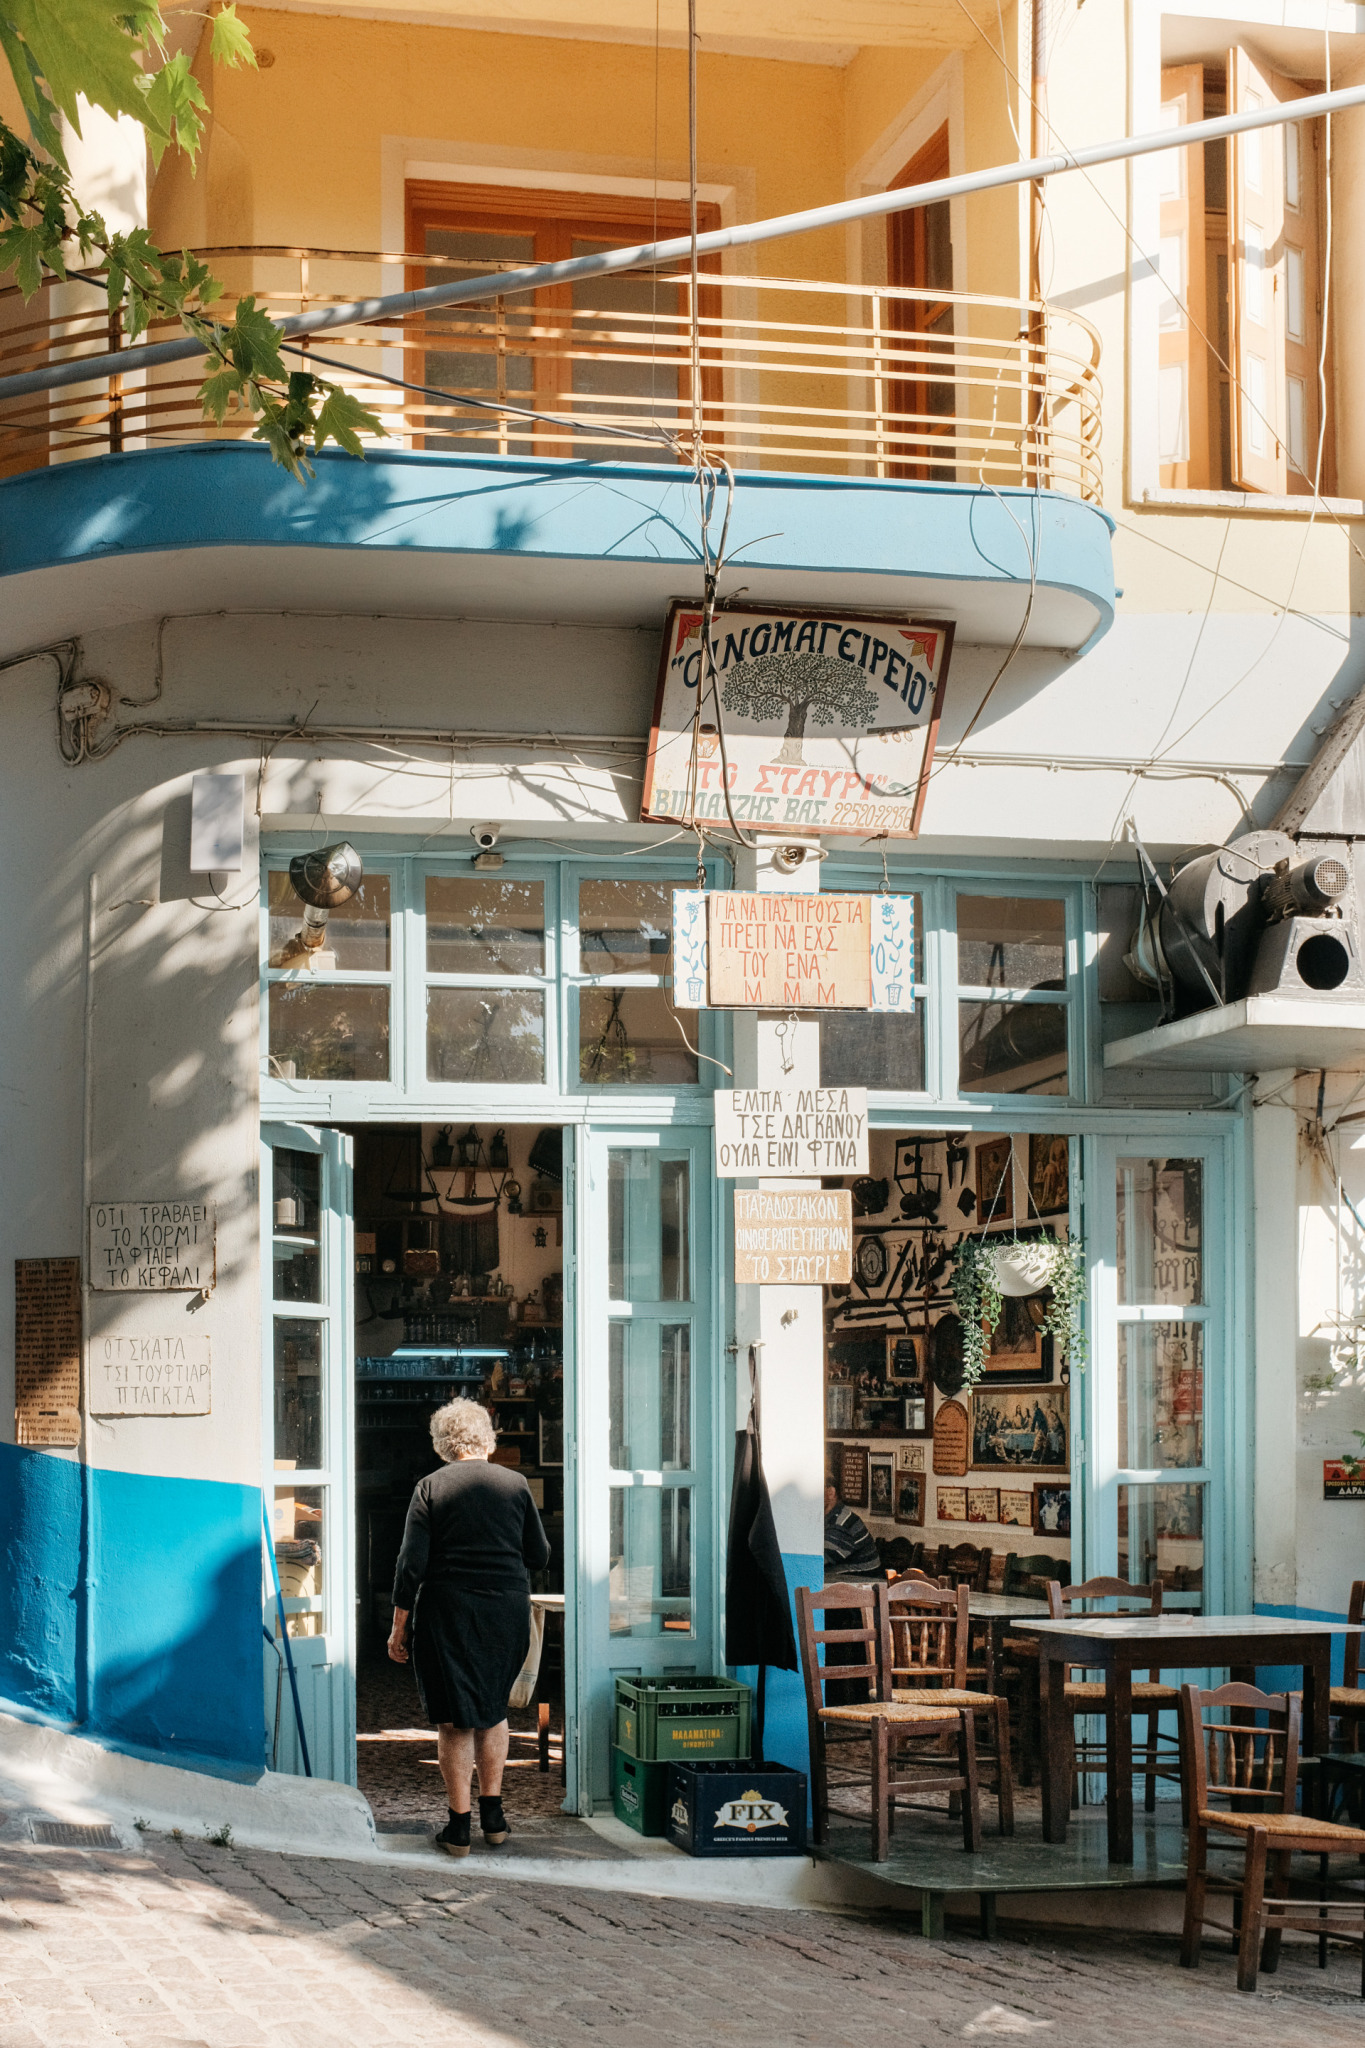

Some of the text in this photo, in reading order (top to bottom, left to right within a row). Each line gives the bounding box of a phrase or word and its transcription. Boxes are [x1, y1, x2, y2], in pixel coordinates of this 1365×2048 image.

[783, 798, 827, 824] ΒΑΣ.
[830, 802, 913, 829] 22520-22936
[715, 896, 737, 920] ΓΙΑ
[740, 898, 757, 921] ΝΑ
[762, 898, 790, 922] ΠΑΣ
[720, 923, 838, 951] ΠΡΕΠ ΝΑ ΕΧΣ
[739, 951, 821, 979] ΤΟΥ ΕΝΑ
[796, 1089, 848, 1112] ΜΕΣΑ
[736, 1113, 865, 1139] ΤΣΕ ΔΑΓΚΑΝΟΥ
[720, 1139, 857, 1167] ΟΥΛΑ ΕΙΝΙ ΦΤΝΑ
[97, 1205, 207, 1228] ΟΤΙ ΤΡΑΒΑΕΙ
[738, 1195, 843, 1219] ΠΑΡΑΔΟΣΙΑΚΟΝ.
[111, 1225, 197, 1247] ΤΟ ΚΟΡΜΙ
[104, 1247, 180, 1266] ΤΑ ΦΤΑΙΕΙ
[107, 1267, 199, 1286] ΤΟ ΚΕΦΑΛΙ
[104, 1365, 128, 1382] ΤΣΙ
[729, 1804, 775, 1821] FIX
